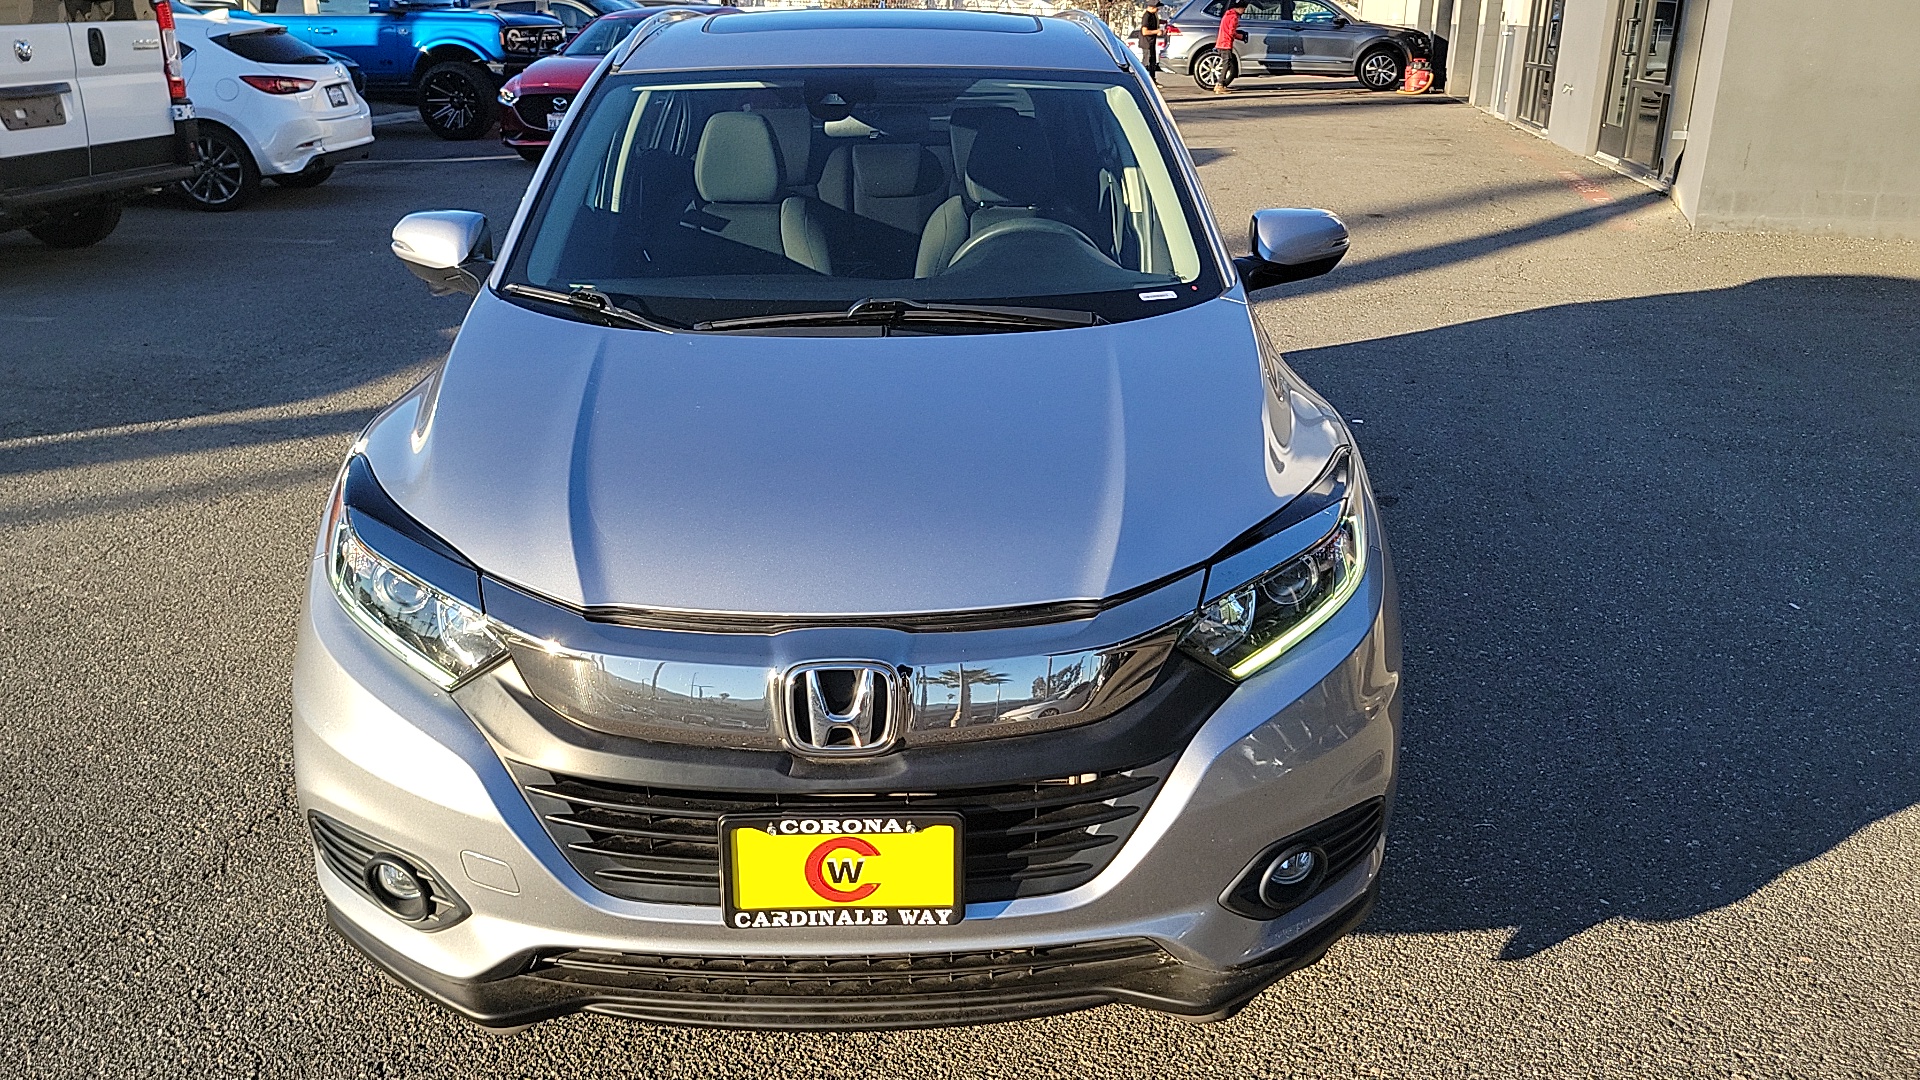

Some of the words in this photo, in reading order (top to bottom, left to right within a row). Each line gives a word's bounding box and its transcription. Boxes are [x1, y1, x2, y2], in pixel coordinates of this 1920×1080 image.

[779, 818, 904, 834] CORONA
[734, 909, 889, 928] CARDINALE
[898, 909, 953, 926] WAY
